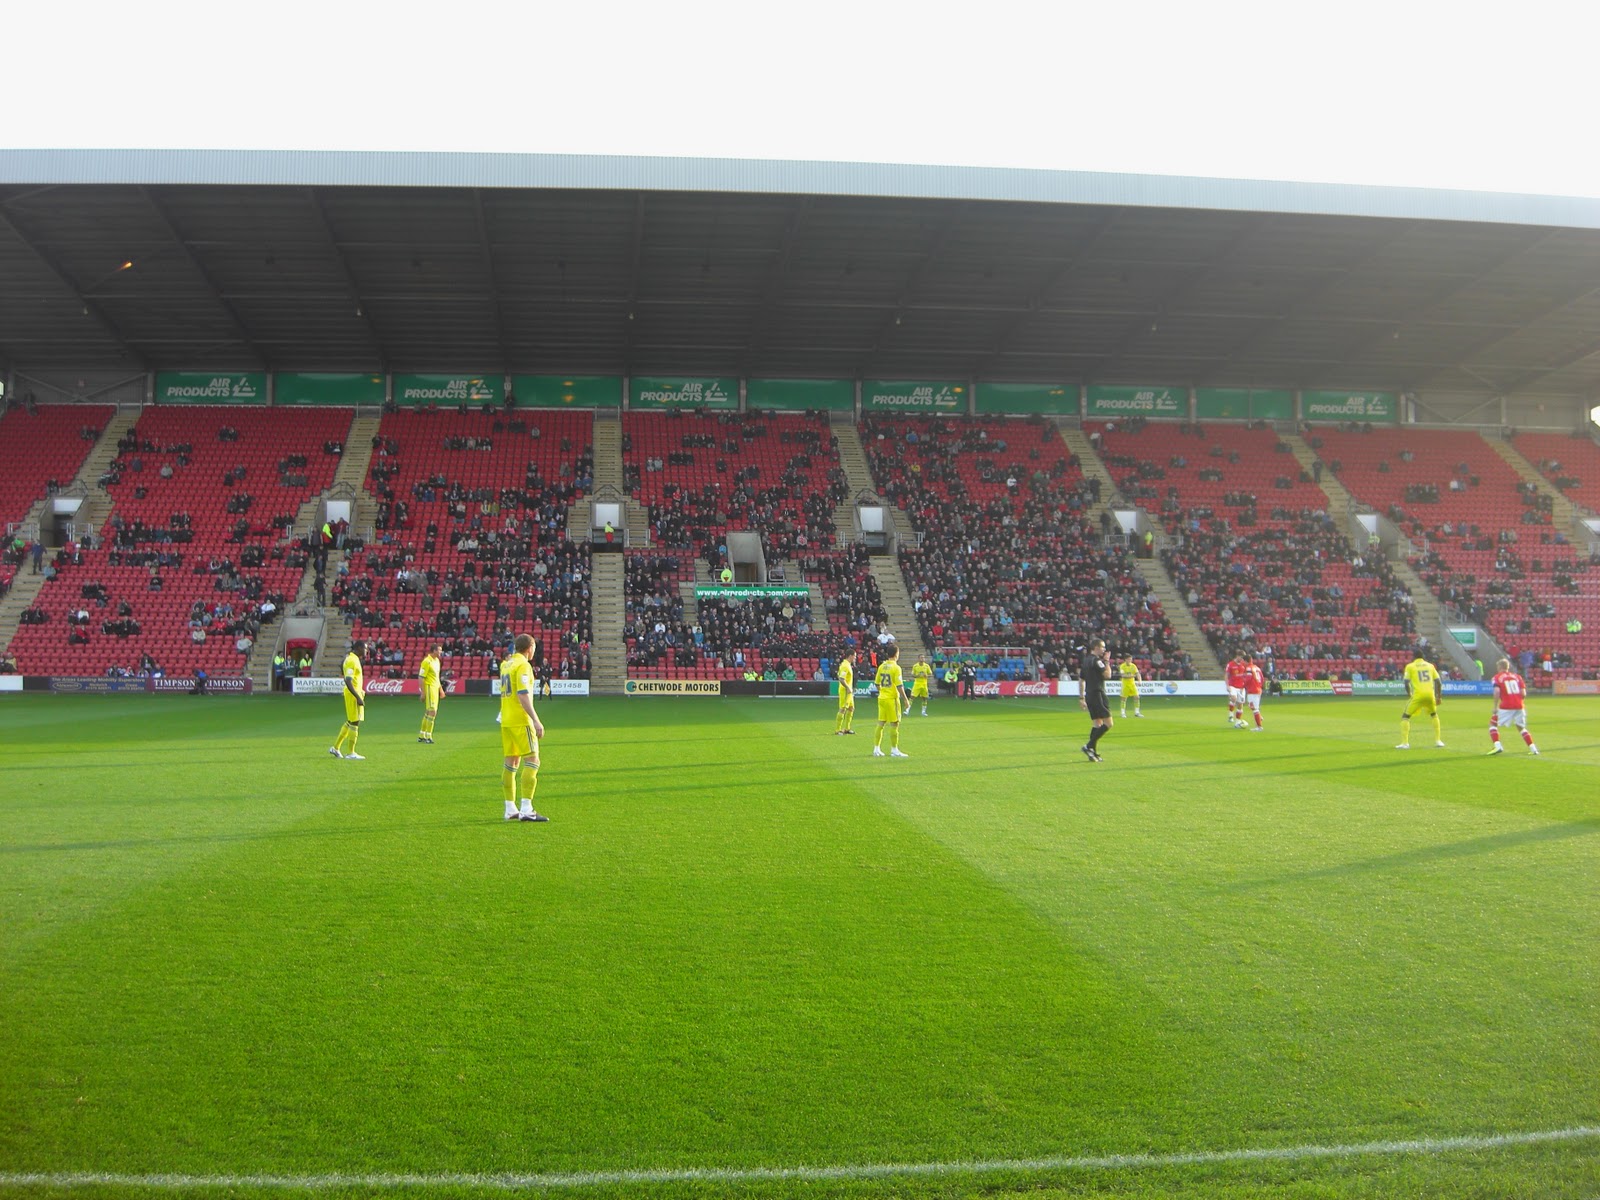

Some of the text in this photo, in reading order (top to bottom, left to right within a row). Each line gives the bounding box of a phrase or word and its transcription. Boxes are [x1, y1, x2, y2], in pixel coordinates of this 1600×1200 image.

[209, 378, 231, 387] AIR
[447, 380, 468, 389] AIR
[167, 387, 230, 396] PRODUCTS
[682, 383, 703, 392] AIR
[913, 387, 933, 396] AIR
[405, 389, 467, 399] PRODUCTS
[640, 392, 702, 401] PRODUCTS
[1135, 391, 1154, 400] AIR
[873, 395, 932, 405] PRODUCTS
[1096, 400, 1153, 409] PRODUCTS
[1347, 397, 1365, 405] AIR
[1310, 404, 1364, 414] PRODUCTS
[880, 673, 892, 688] 23
[1418, 670, 1431, 682] 15
[154, 679, 195, 687] TIMPSON
[638, 683, 719, 692] CHETWODE MOTORS
[1504, 680, 1520, 694] 10
